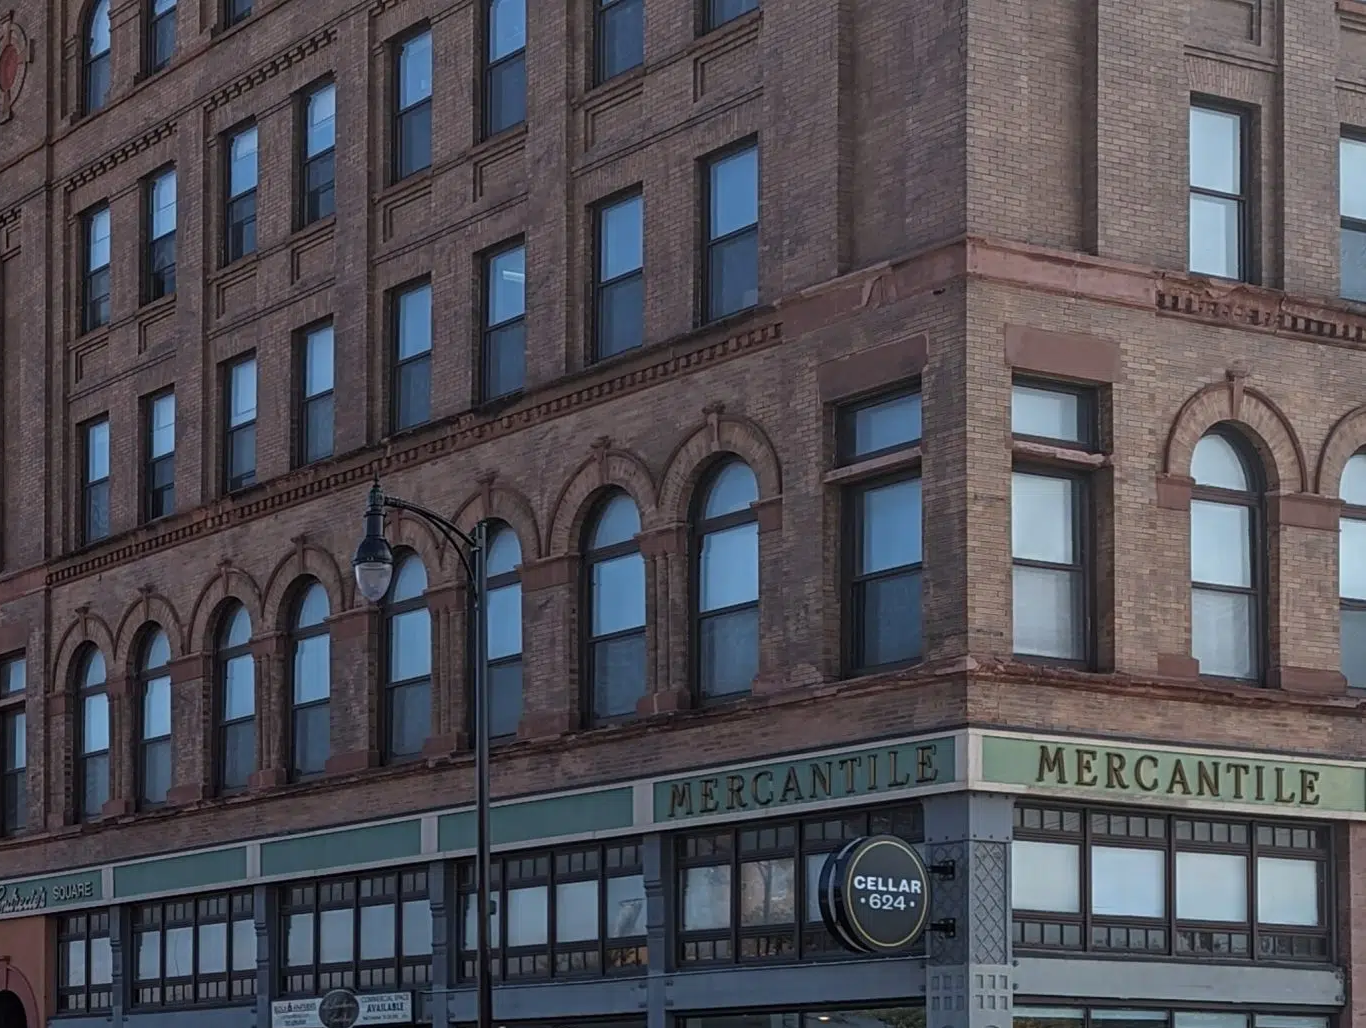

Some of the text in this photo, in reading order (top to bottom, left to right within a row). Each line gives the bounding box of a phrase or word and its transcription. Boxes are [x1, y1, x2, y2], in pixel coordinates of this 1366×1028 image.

[668, 743, 939, 818] MERCANTILE
[1036, 745, 1321, 806] MERCANTILE
[52, 881, 93, 900] SQUARE
[853, 875, 922, 894] CELLAR
[869, 893, 907, 911] 624
[366, 1002, 404, 1013] AVAILABLE
